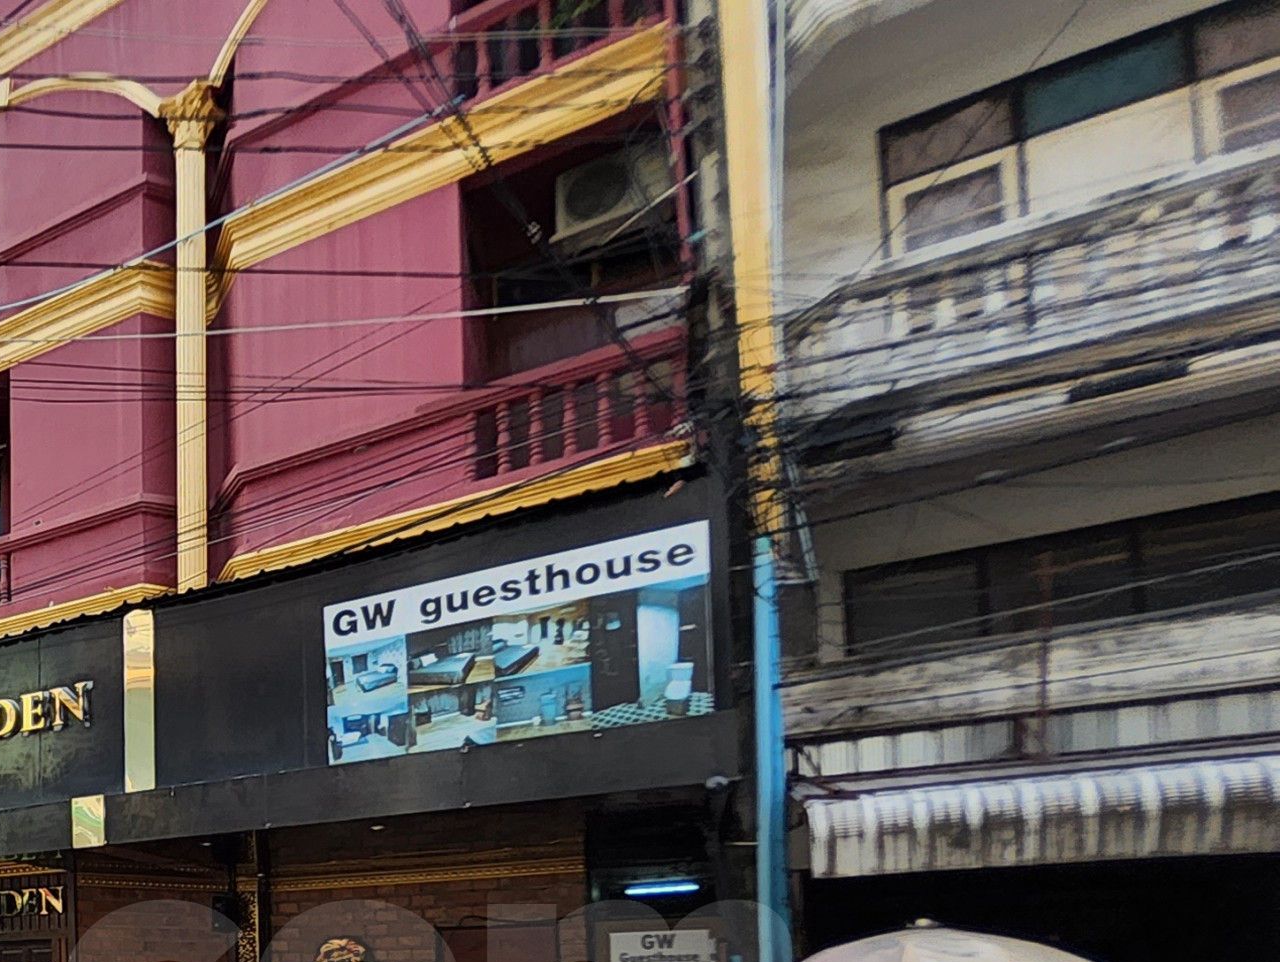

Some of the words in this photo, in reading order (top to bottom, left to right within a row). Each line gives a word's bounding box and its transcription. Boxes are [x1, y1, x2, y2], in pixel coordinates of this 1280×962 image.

[332, 598, 397, 637] GW
[419, 542, 695, 625] guesthouse
[641, 933, 677, 951] GW
